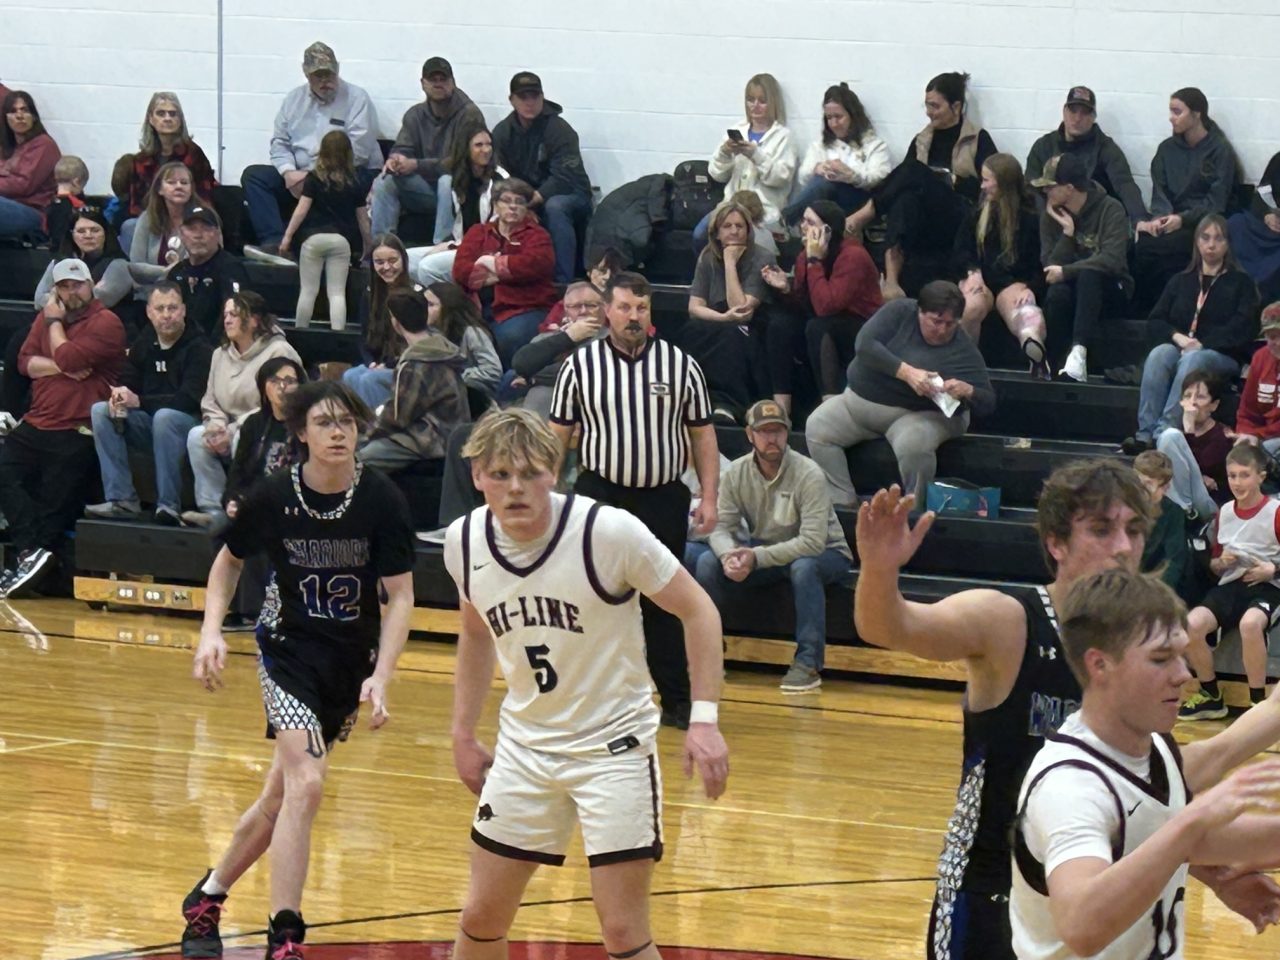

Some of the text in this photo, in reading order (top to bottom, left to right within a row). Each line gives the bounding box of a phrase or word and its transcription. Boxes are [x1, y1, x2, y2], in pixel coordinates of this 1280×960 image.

[299, 574, 361, 621] 12
[486, 595, 585, 638] HI-LINE
[524, 643, 558, 693] 5
